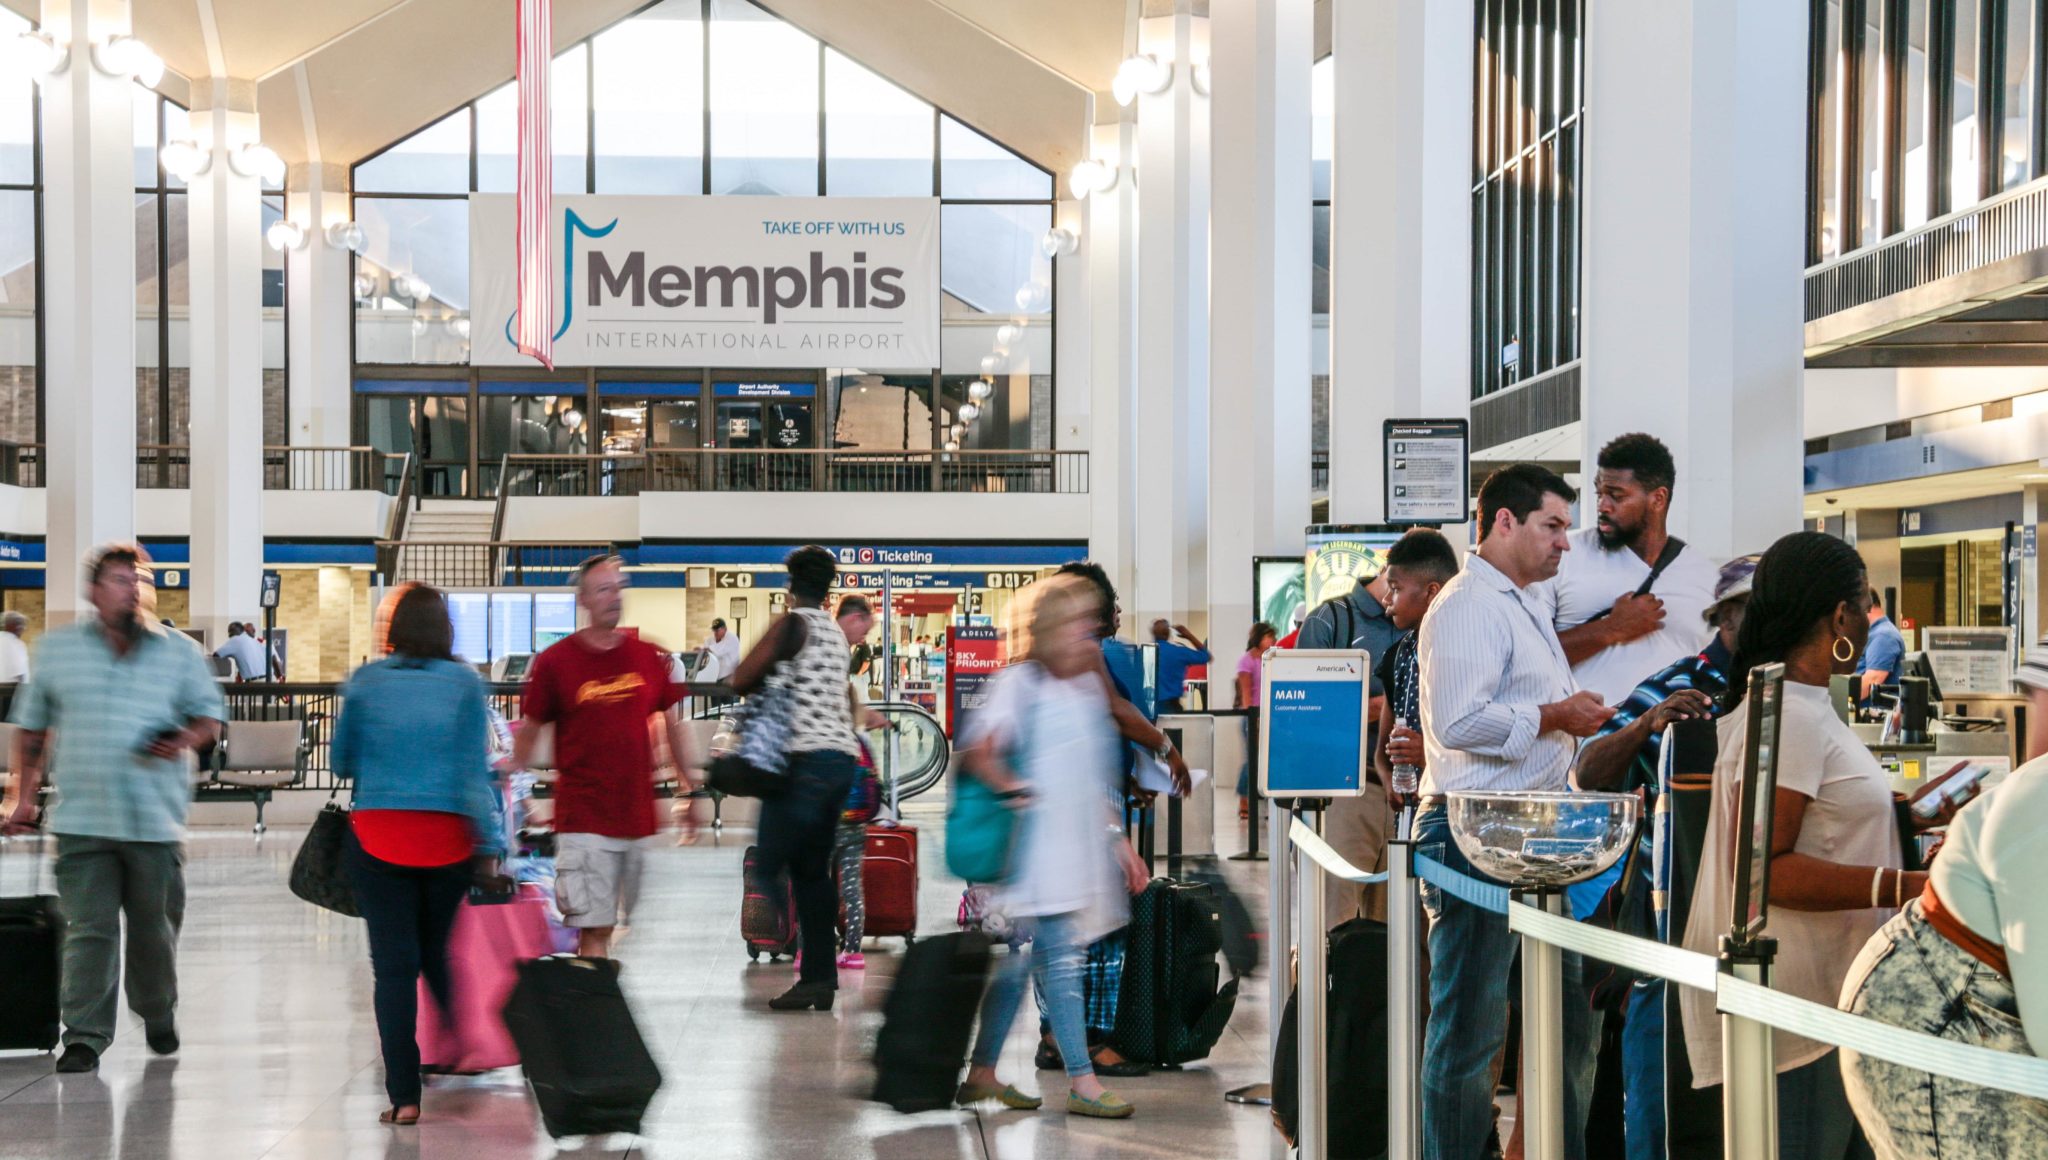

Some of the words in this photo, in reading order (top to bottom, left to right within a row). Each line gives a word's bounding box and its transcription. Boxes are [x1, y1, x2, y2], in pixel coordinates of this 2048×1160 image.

[762, 221, 801, 235] TAKE
[805, 221, 834, 235] OFF
[838, 221, 879, 236] WITH
[883, 222, 905, 236] US
[587, 250, 906, 325] Memphis
[587, 332, 787, 349] INTERNATIONAL
[800, 333, 905, 350] AIRPORT
[877, 550, 933, 564] Ticketing
[862, 575, 913, 588] Tickting
[956, 652, 977, 660] SKY
[956, 660, 1002, 668] PRIORITY
[1275, 690, 1306, 700] MAIN
